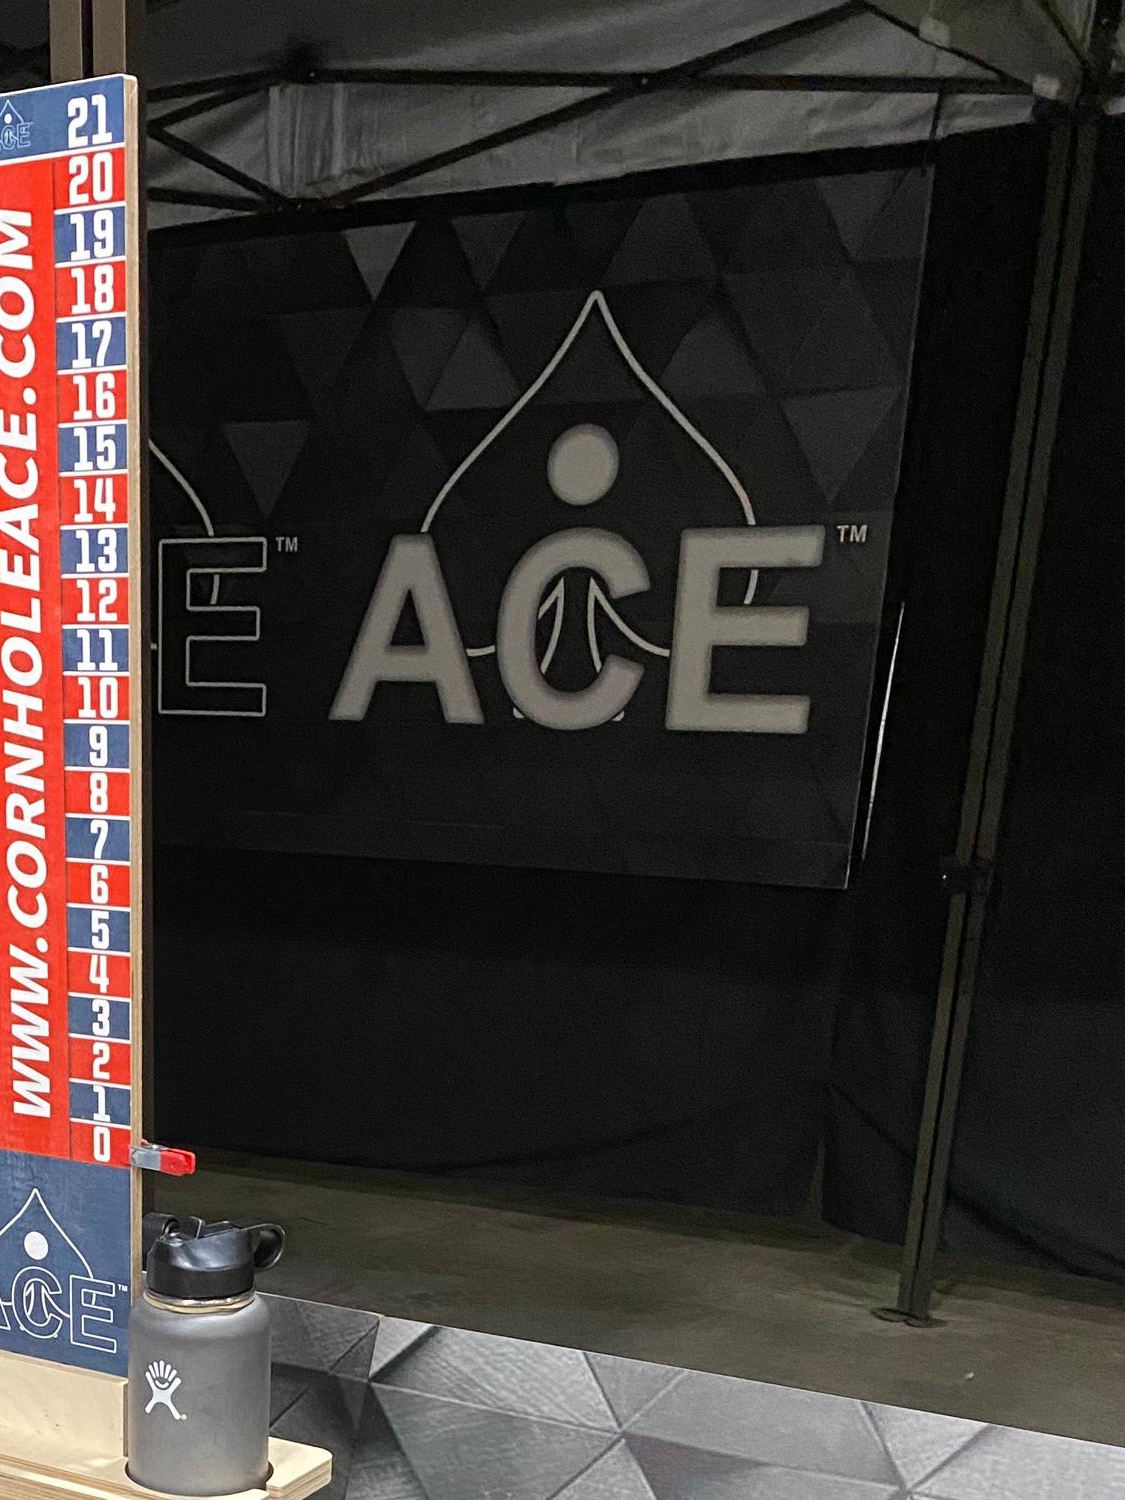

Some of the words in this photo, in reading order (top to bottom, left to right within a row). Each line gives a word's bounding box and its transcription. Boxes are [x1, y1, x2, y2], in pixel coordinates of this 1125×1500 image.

[67, 93, 113, 149] 21
[68, 151, 113, 206] 20
[70, 209, 114, 261] 19
[70, 264, 114, 315] 18
[71, 320, 113, 368] 17
[72, 372, 116, 420] 16
[73, 425, 116, 470] 15
[73, 477, 116, 523] 14
[75, 528, 118, 573] 13
[76, 578, 118, 622] 12
[75, 628, 118, 671] 11
[329, 525, 825, 734] ACE
[77, 676, 119, 719] 10
[88, 725, 108, 767] 9
[89, 772, 108, 813] 8
[90, 819, 109, 859] 7
[90, 864, 109, 905] 6
[91, 909, 110, 950] 5
[89, 954, 110, 994] 4
[92, 998, 111, 1037] 3
[92, 1041, 110, 1080] 2
[92, 1085, 111, 1122] 1
[93, 1125, 111, 1163] 0
